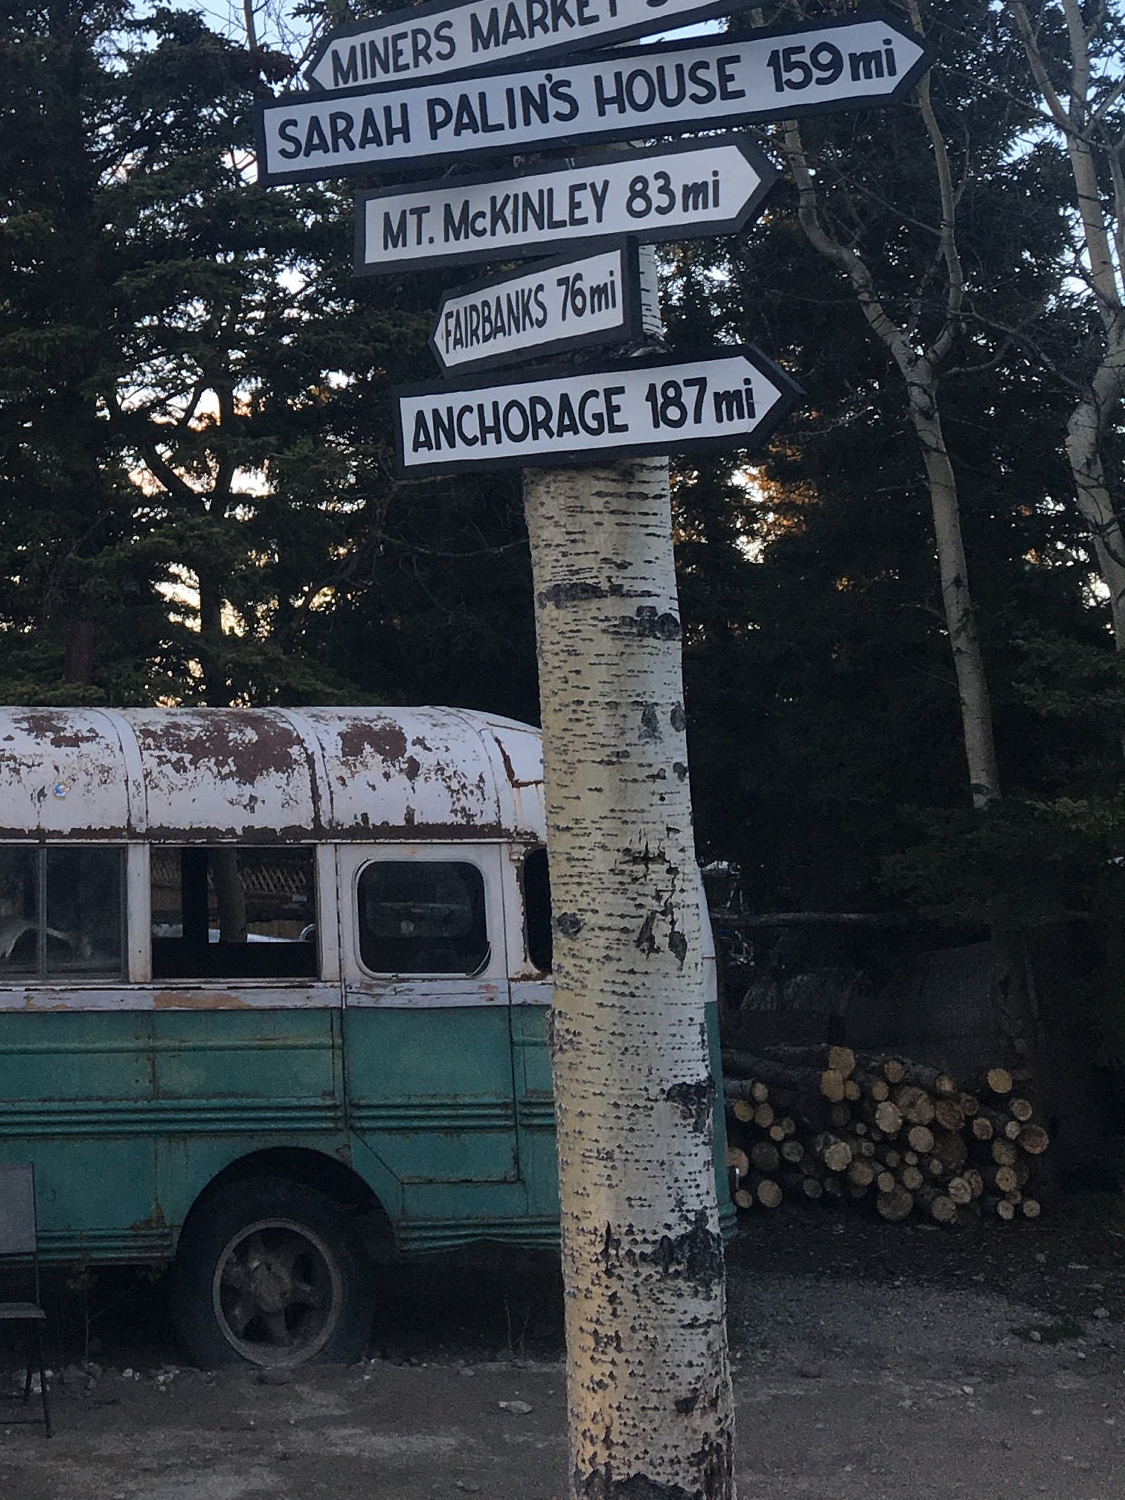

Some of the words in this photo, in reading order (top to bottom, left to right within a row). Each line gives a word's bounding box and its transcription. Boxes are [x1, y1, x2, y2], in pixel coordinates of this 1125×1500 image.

[330, 20, 455, 88] MINERS
[278, 104, 411, 160] SARAH
[428, 73, 579, 142] PALIN'S
[596, 55, 746, 118] HOUSE
[382, 212, 435, 250] MT.
[443, 179, 610, 243] McKINLEY
[443, 284, 548, 355] FAIRBANKS
[412, 384, 630, 453] ANCHORAGE
